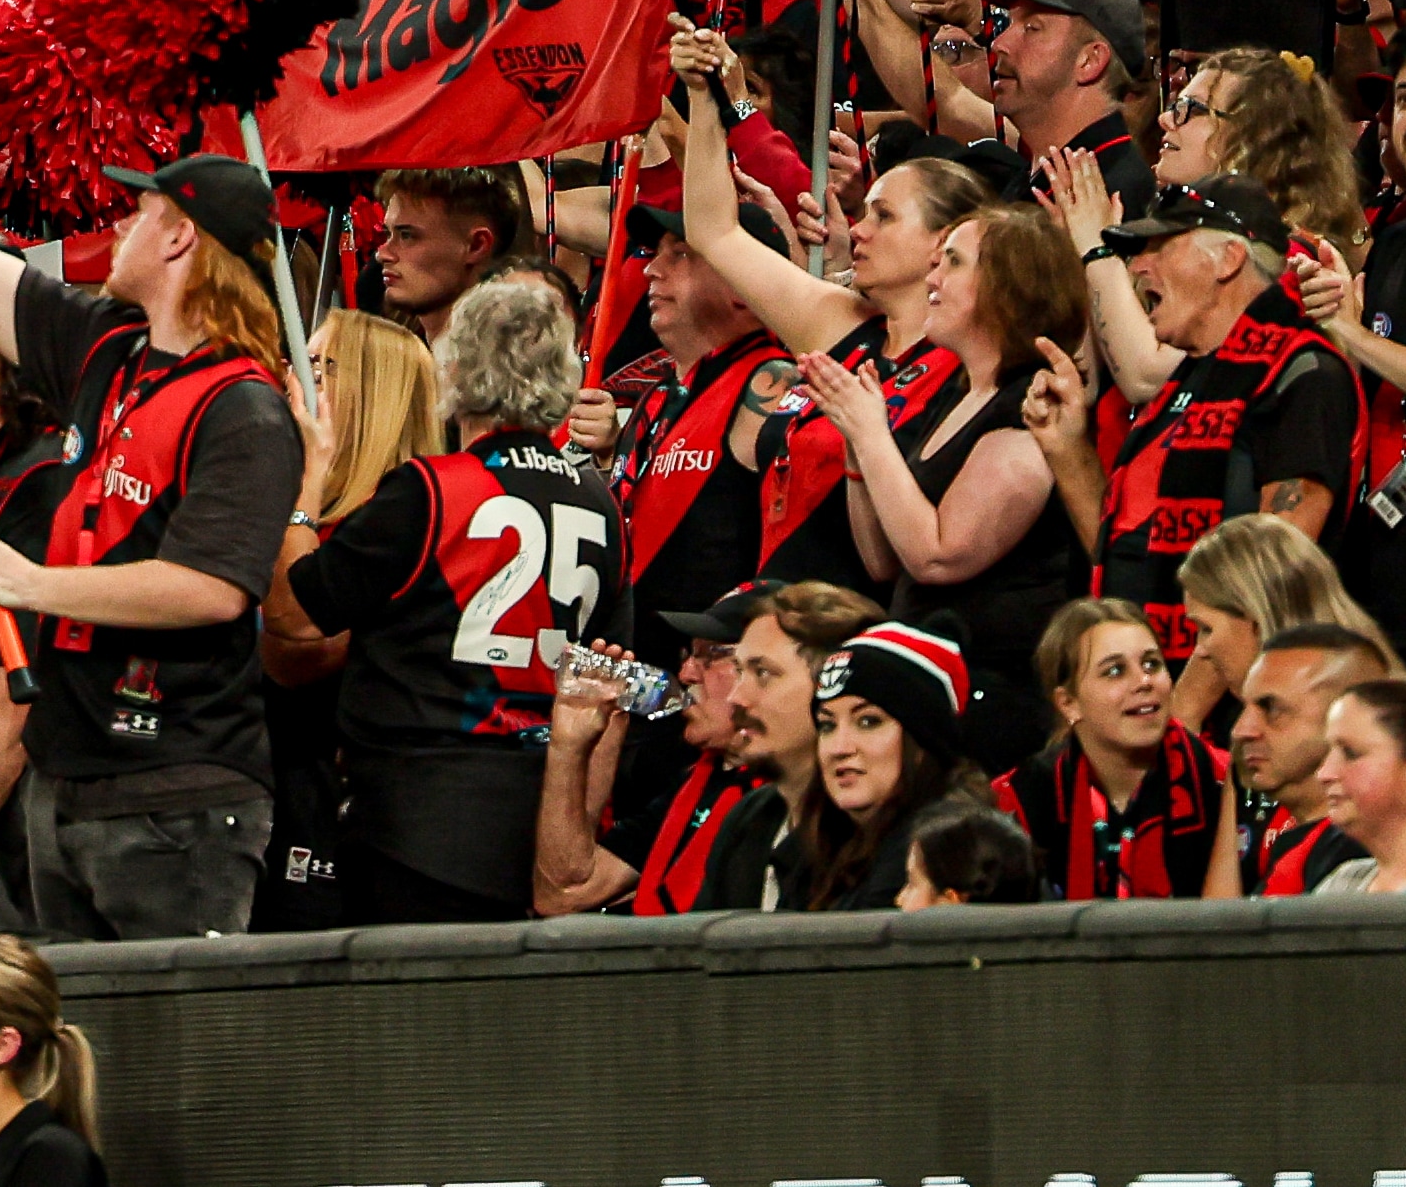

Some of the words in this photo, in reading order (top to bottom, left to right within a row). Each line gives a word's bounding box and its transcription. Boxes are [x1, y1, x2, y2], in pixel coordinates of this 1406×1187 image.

[492, 42, 587, 73] ESSENDON
[651, 438, 714, 479] FUJITSU
[451, 495, 607, 671] 25
